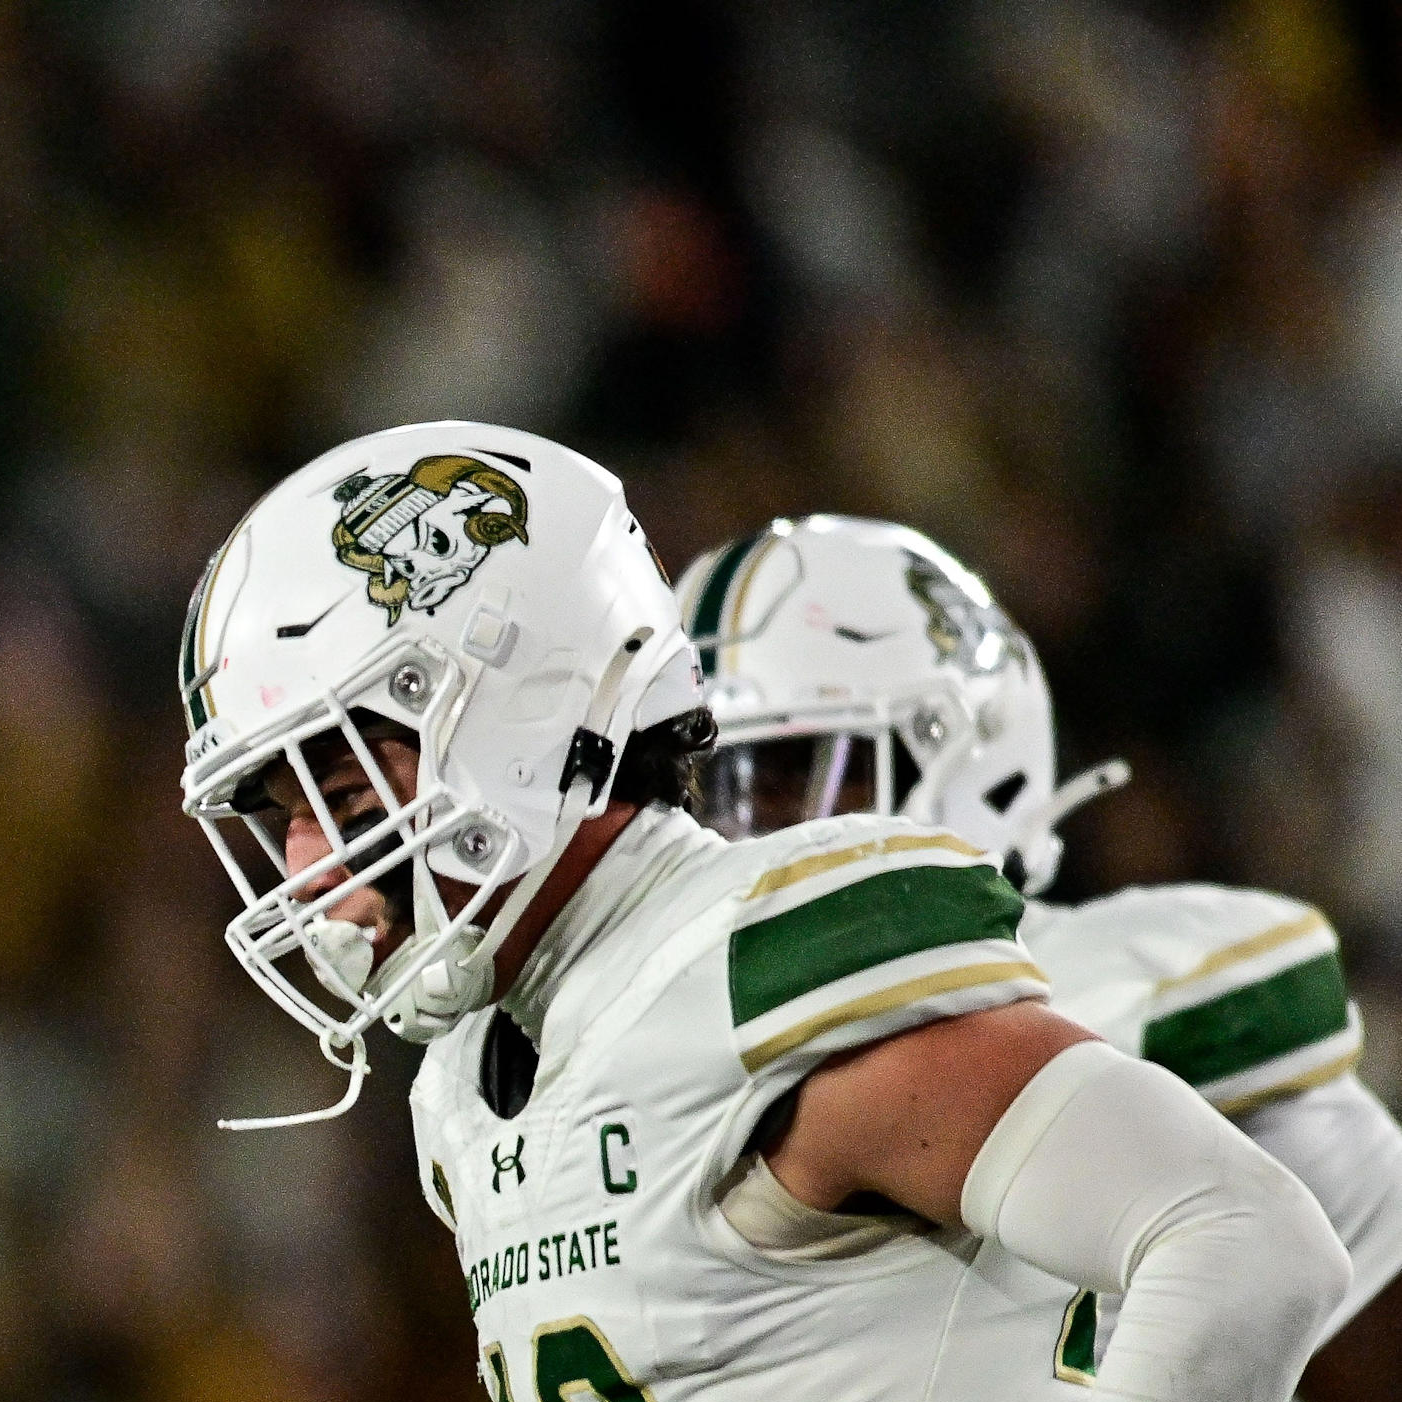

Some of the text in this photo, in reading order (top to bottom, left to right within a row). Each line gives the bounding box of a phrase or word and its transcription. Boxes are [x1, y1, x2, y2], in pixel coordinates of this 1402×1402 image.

[600, 1123, 638, 1194] C
[465, 1219, 621, 1312] ORADO STATE
